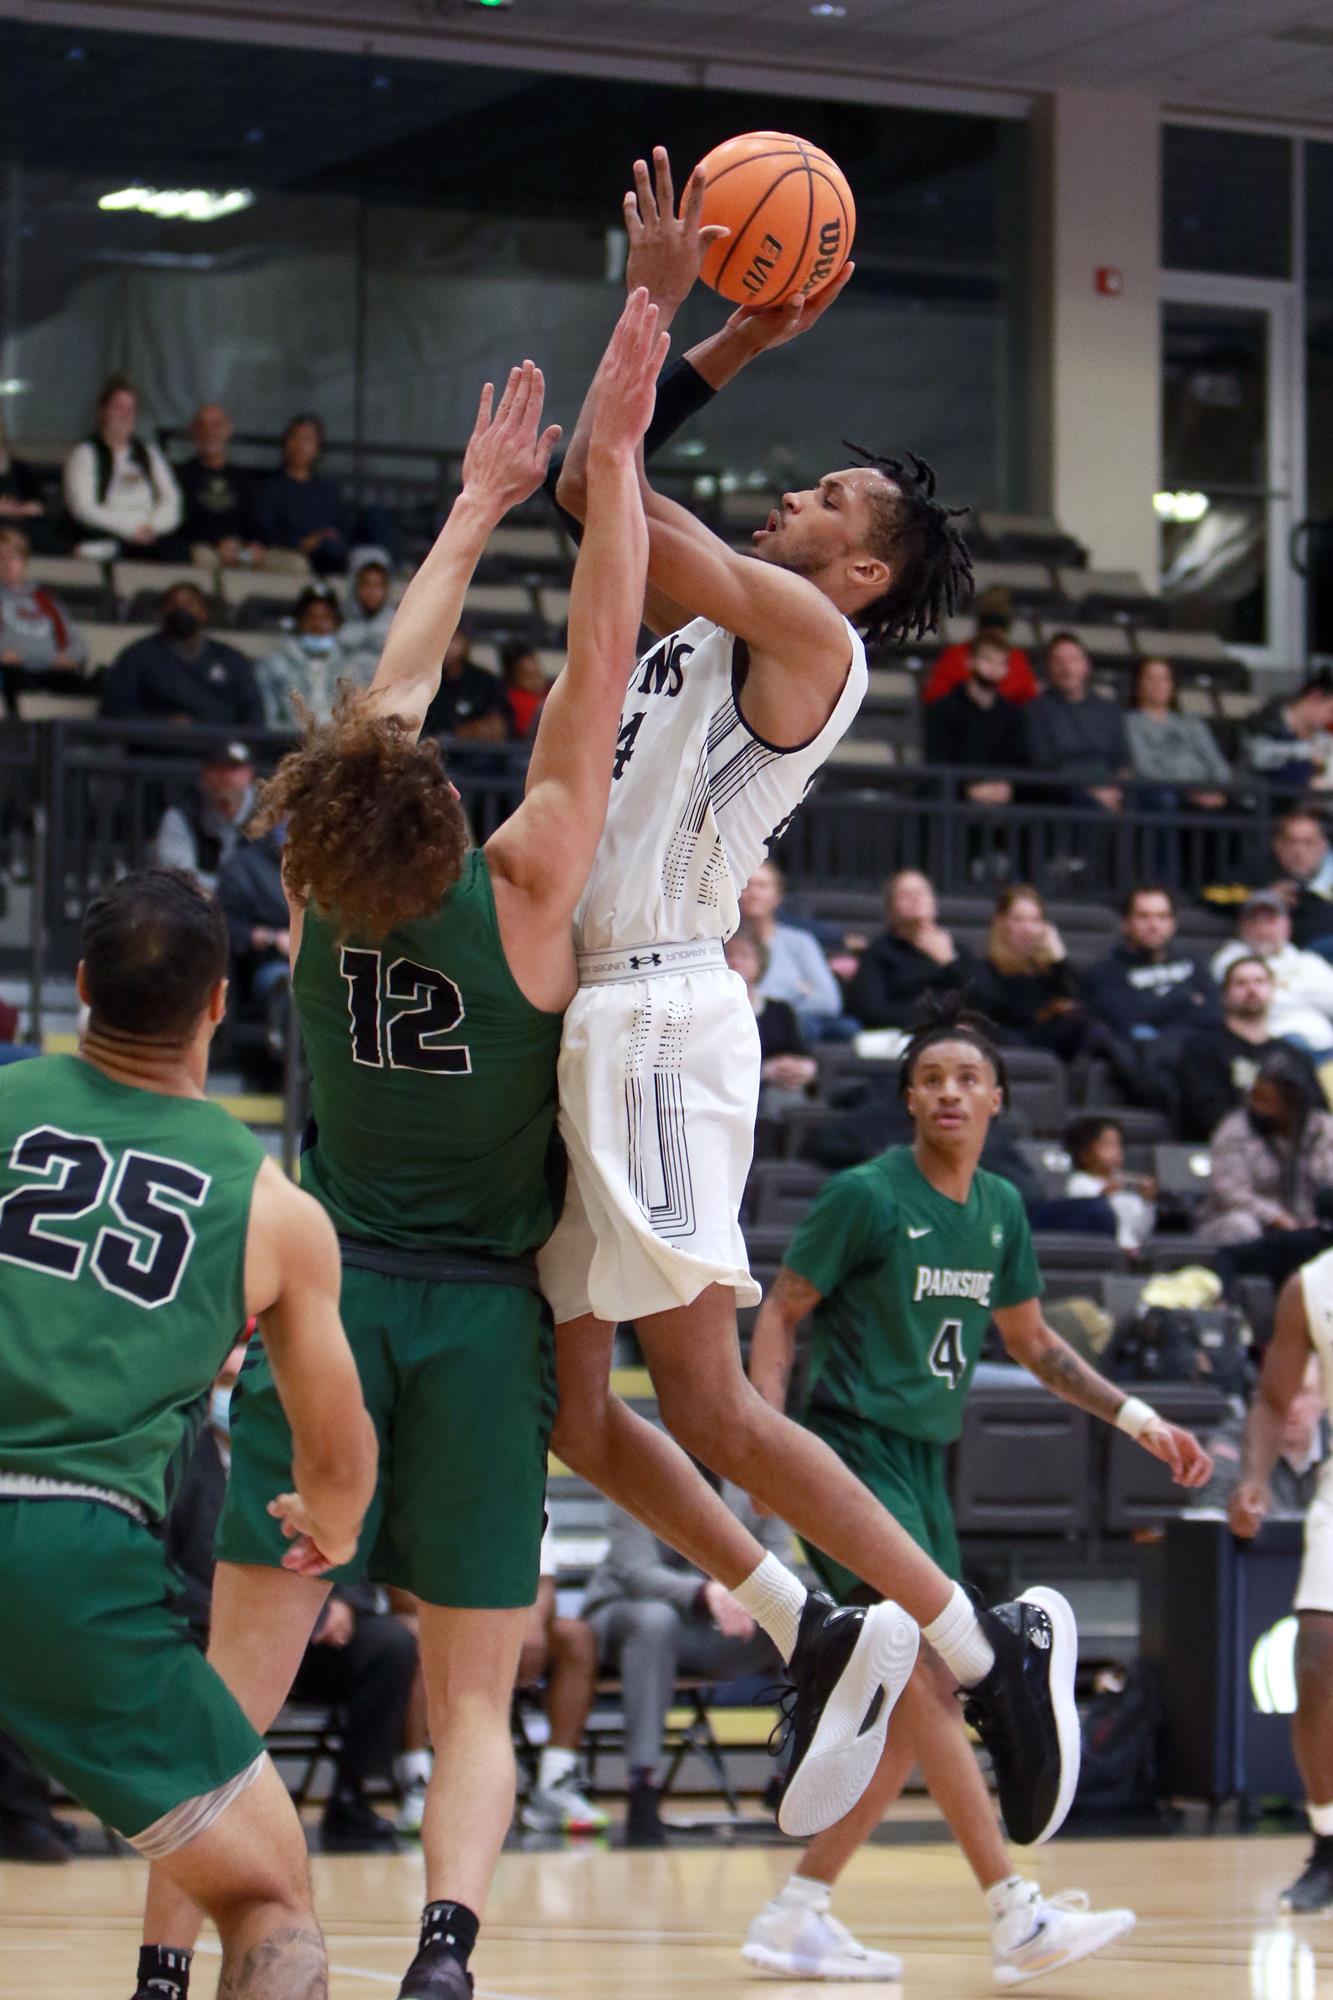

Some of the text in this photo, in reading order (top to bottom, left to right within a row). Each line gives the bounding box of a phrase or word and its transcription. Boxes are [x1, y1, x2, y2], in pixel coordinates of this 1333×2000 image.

[628, 634, 697, 697] NS
[611, 711, 648, 781] 4
[340, 946, 472, 1075] 12
[0, 1124, 212, 1310] 25
[914, 1265, 994, 1308] PARKSIDE
[929, 1319, 967, 1390] 4
